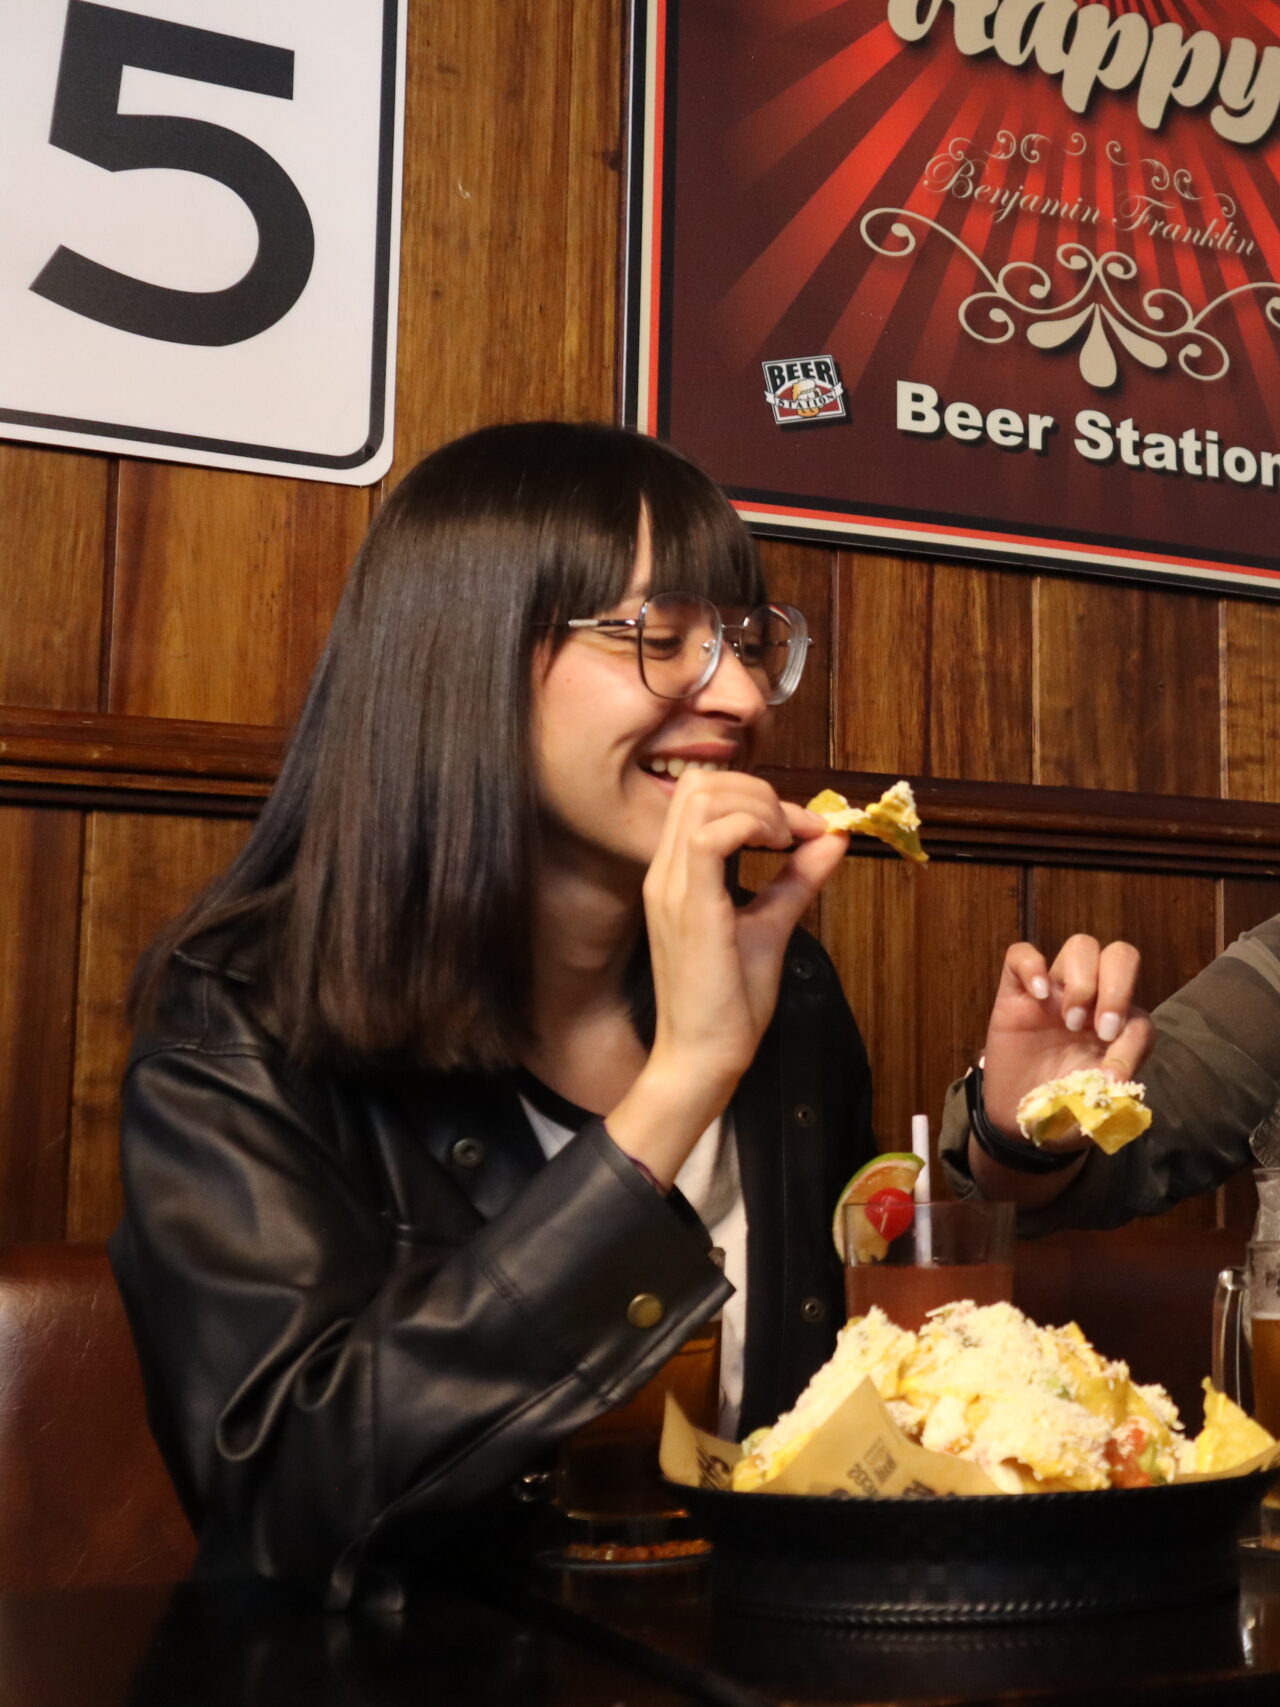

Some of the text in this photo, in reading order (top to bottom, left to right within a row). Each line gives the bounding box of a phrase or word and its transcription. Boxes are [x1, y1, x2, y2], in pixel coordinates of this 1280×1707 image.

[29, 0, 316, 347] 5
[923, 152, 1257, 257] Benjamin Franklin
[767, 360, 836, 394] BEER
[778, 394, 835, 410] STATION
[896, 379, 1055, 451] Beer
